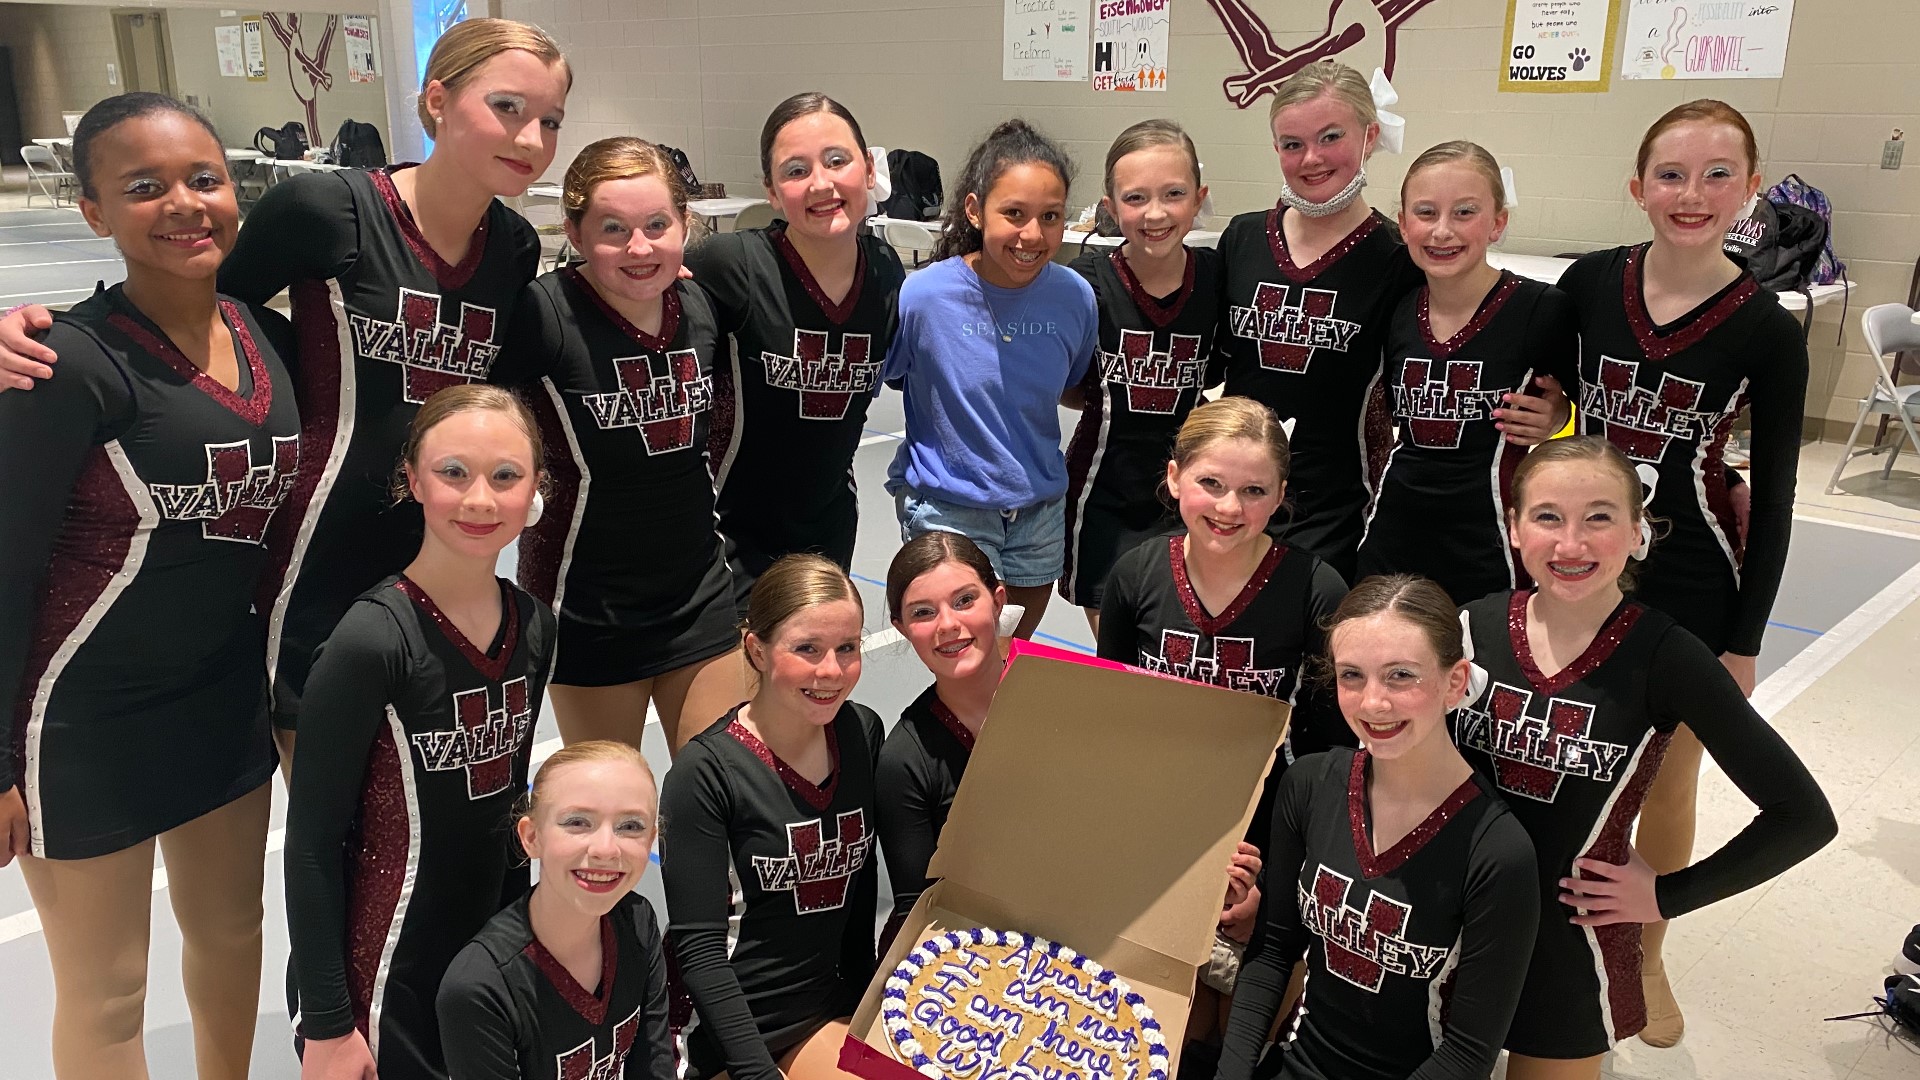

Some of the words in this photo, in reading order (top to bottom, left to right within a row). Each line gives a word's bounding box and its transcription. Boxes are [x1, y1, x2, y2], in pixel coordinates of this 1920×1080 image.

[1509, 66, 1567, 81] WOLVES
[1513, 45, 1535, 60] GO
[1094, 76, 1113, 90] GET
[962, 322, 1057, 336] SEASIDE
[1229, 305, 1361, 352] VALLEY
[1095, 347, 1209, 389] VALLEY
[1580, 381, 1728, 442] VALLEY
[150, 472, 298, 519] VALLE
[412, 709, 531, 771] VALLE
[1457, 708, 1628, 781] VALLEY
[752, 834, 874, 891] VALLE
[924, 970, 967, 1003] I
[971, 995, 1022, 1034] am
[1037, 1021, 1113, 1076] here
[944, 948, 990, 979] I
[1006, 978, 1069, 1020] am
[1077, 1015, 1138, 1053] not
[915, 999, 1004, 1057] Good
